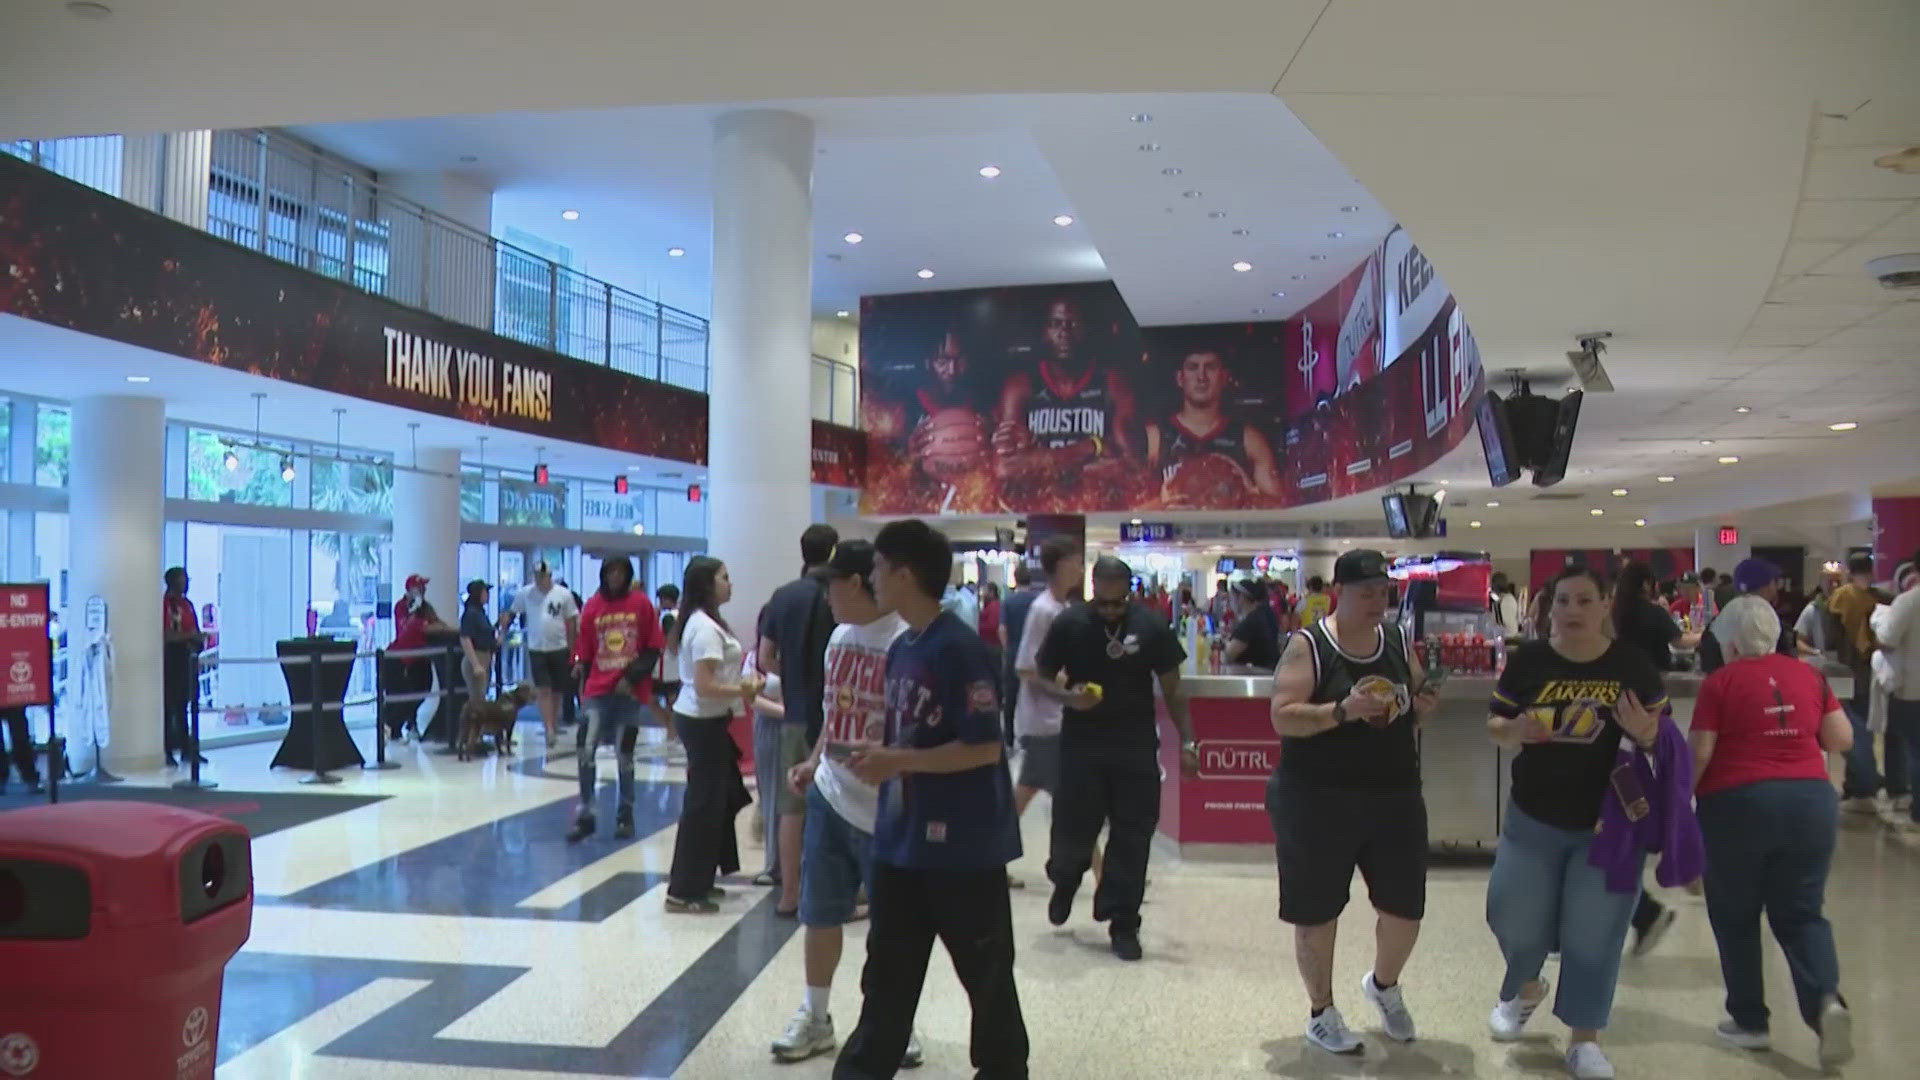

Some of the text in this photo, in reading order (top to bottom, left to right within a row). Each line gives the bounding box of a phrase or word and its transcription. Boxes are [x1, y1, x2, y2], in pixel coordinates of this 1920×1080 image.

[384, 326, 552, 422] THANK YOU, FANS!
[1028, 407, 1104, 438] HOUSTON
[10, 593, 29, 608] NO
[0, 613, 46, 628] E-ENTRY
[1535, 681, 1619, 706] LAKERS
